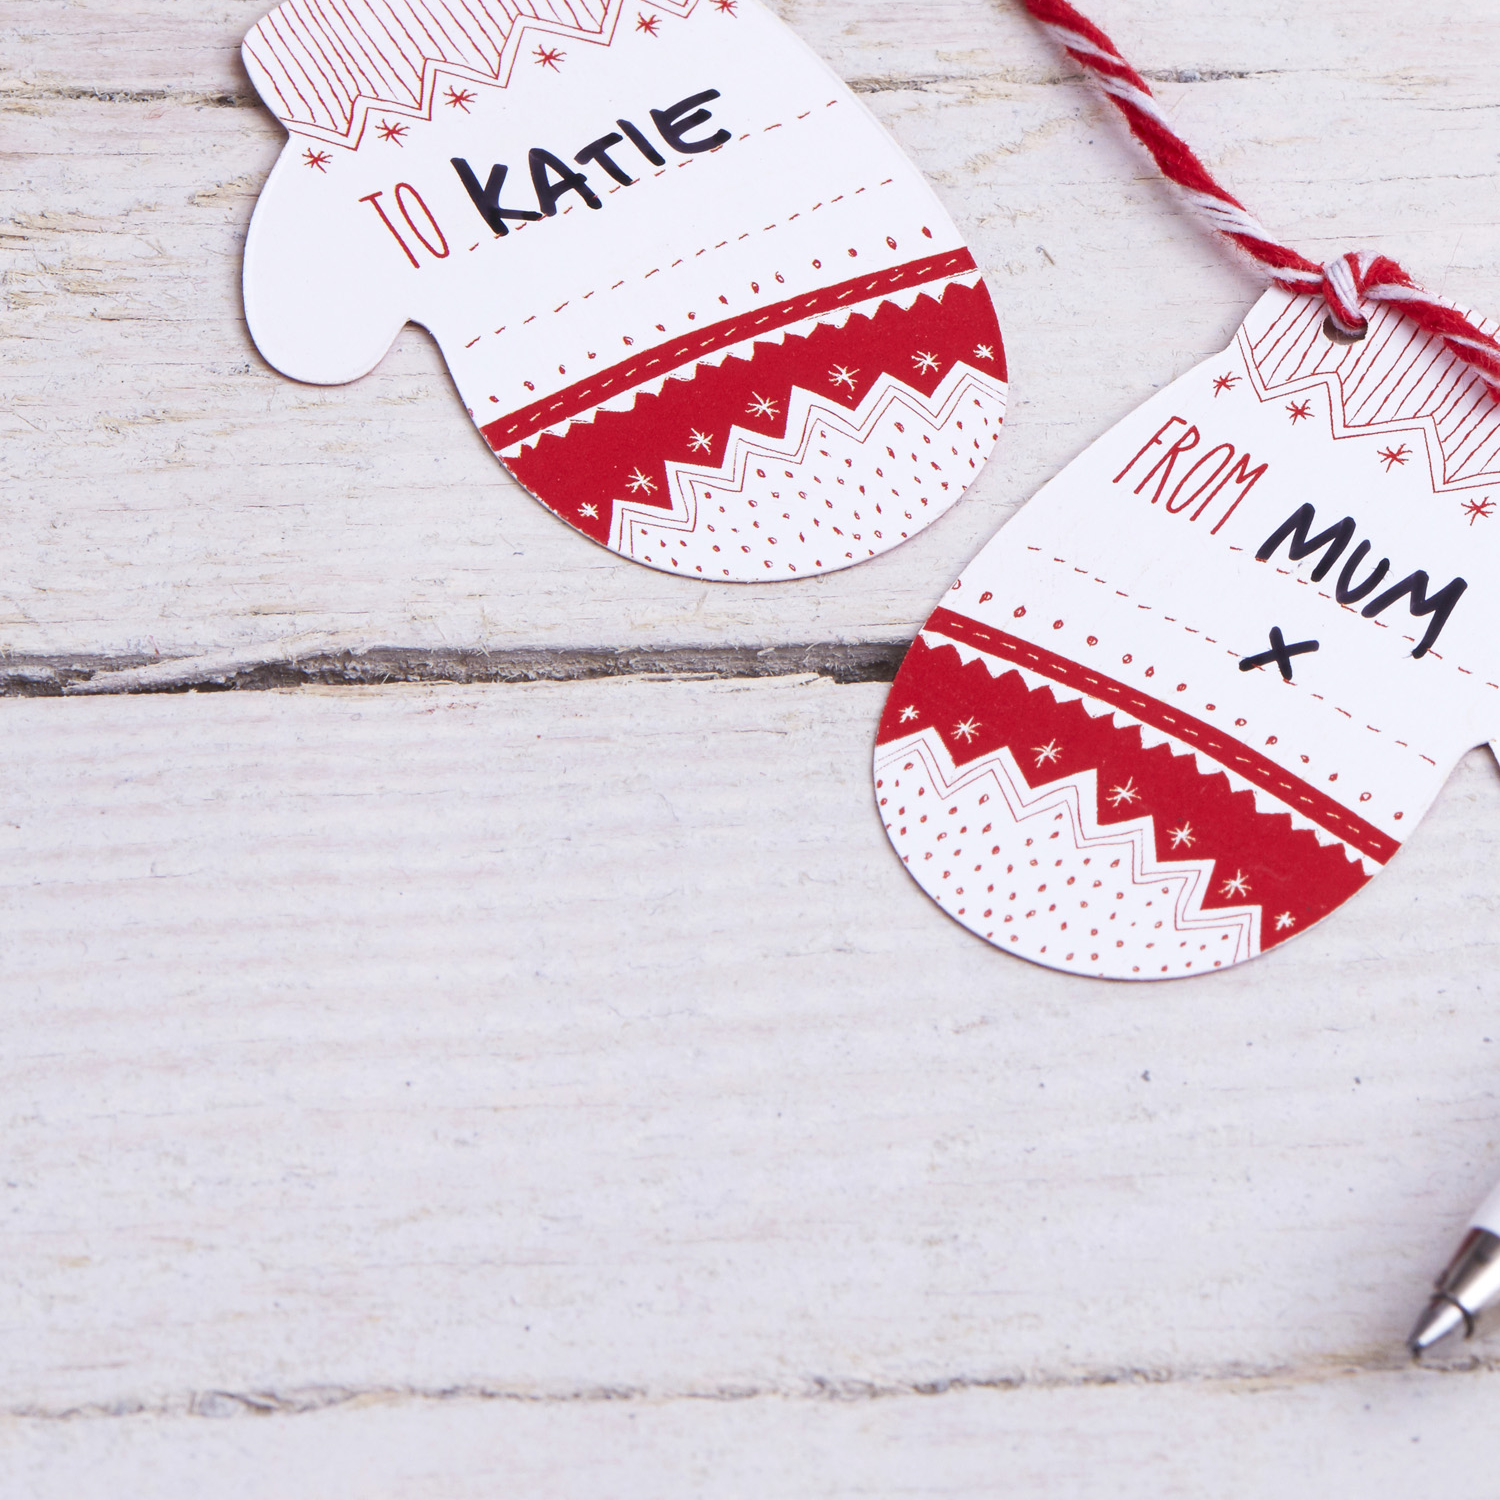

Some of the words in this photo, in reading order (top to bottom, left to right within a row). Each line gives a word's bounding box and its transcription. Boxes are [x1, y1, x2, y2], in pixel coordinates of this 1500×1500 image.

[358, 181, 451, 269] TO
[450, 88, 732, 237] KATIE
[1111, 415, 1269, 536] FROM
[1255, 502, 1468, 659] MUM
